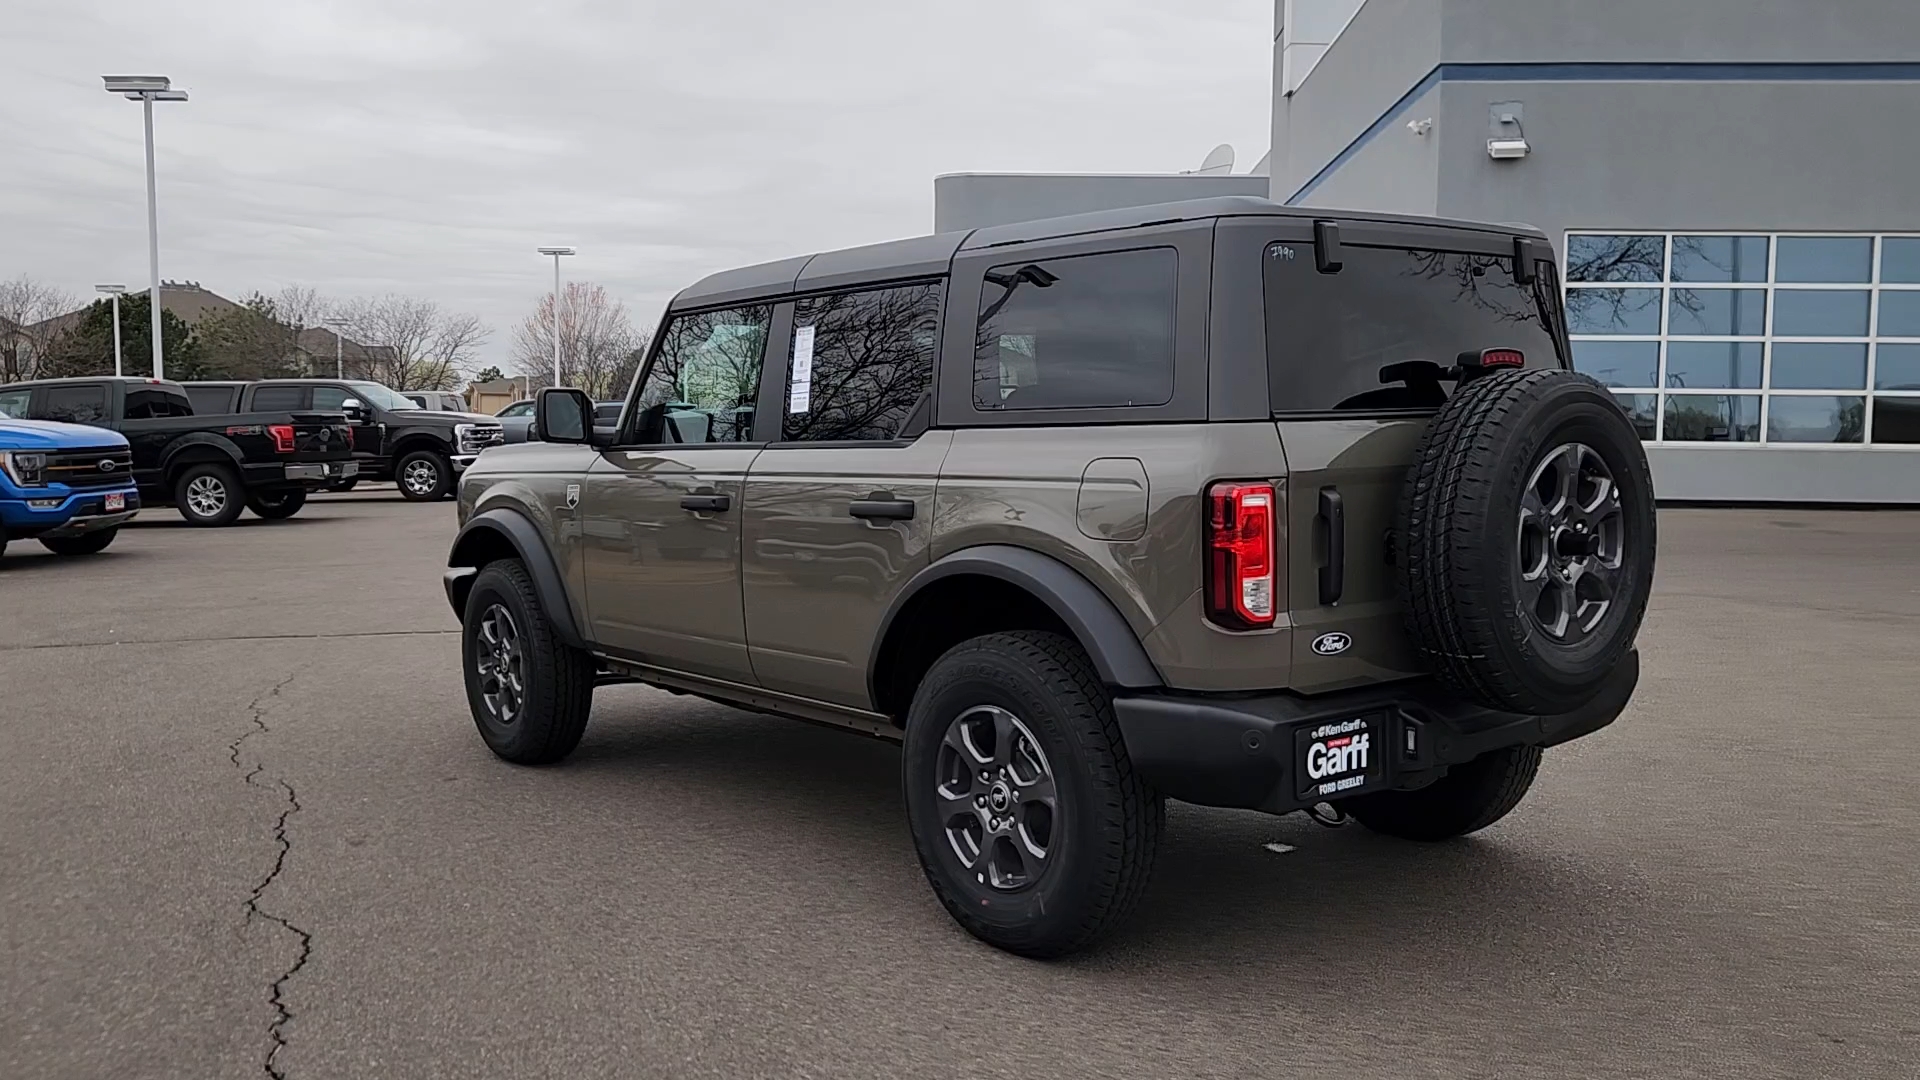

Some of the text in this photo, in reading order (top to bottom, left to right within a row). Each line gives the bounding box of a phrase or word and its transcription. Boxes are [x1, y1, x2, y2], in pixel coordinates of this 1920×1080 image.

[1320, 636, 1345, 651] Ford
[1325, 719, 1361, 737] Ken Garff
[1307, 733, 1369, 779] Garff
[1319, 775, 1365, 796] FORD GREELEY
